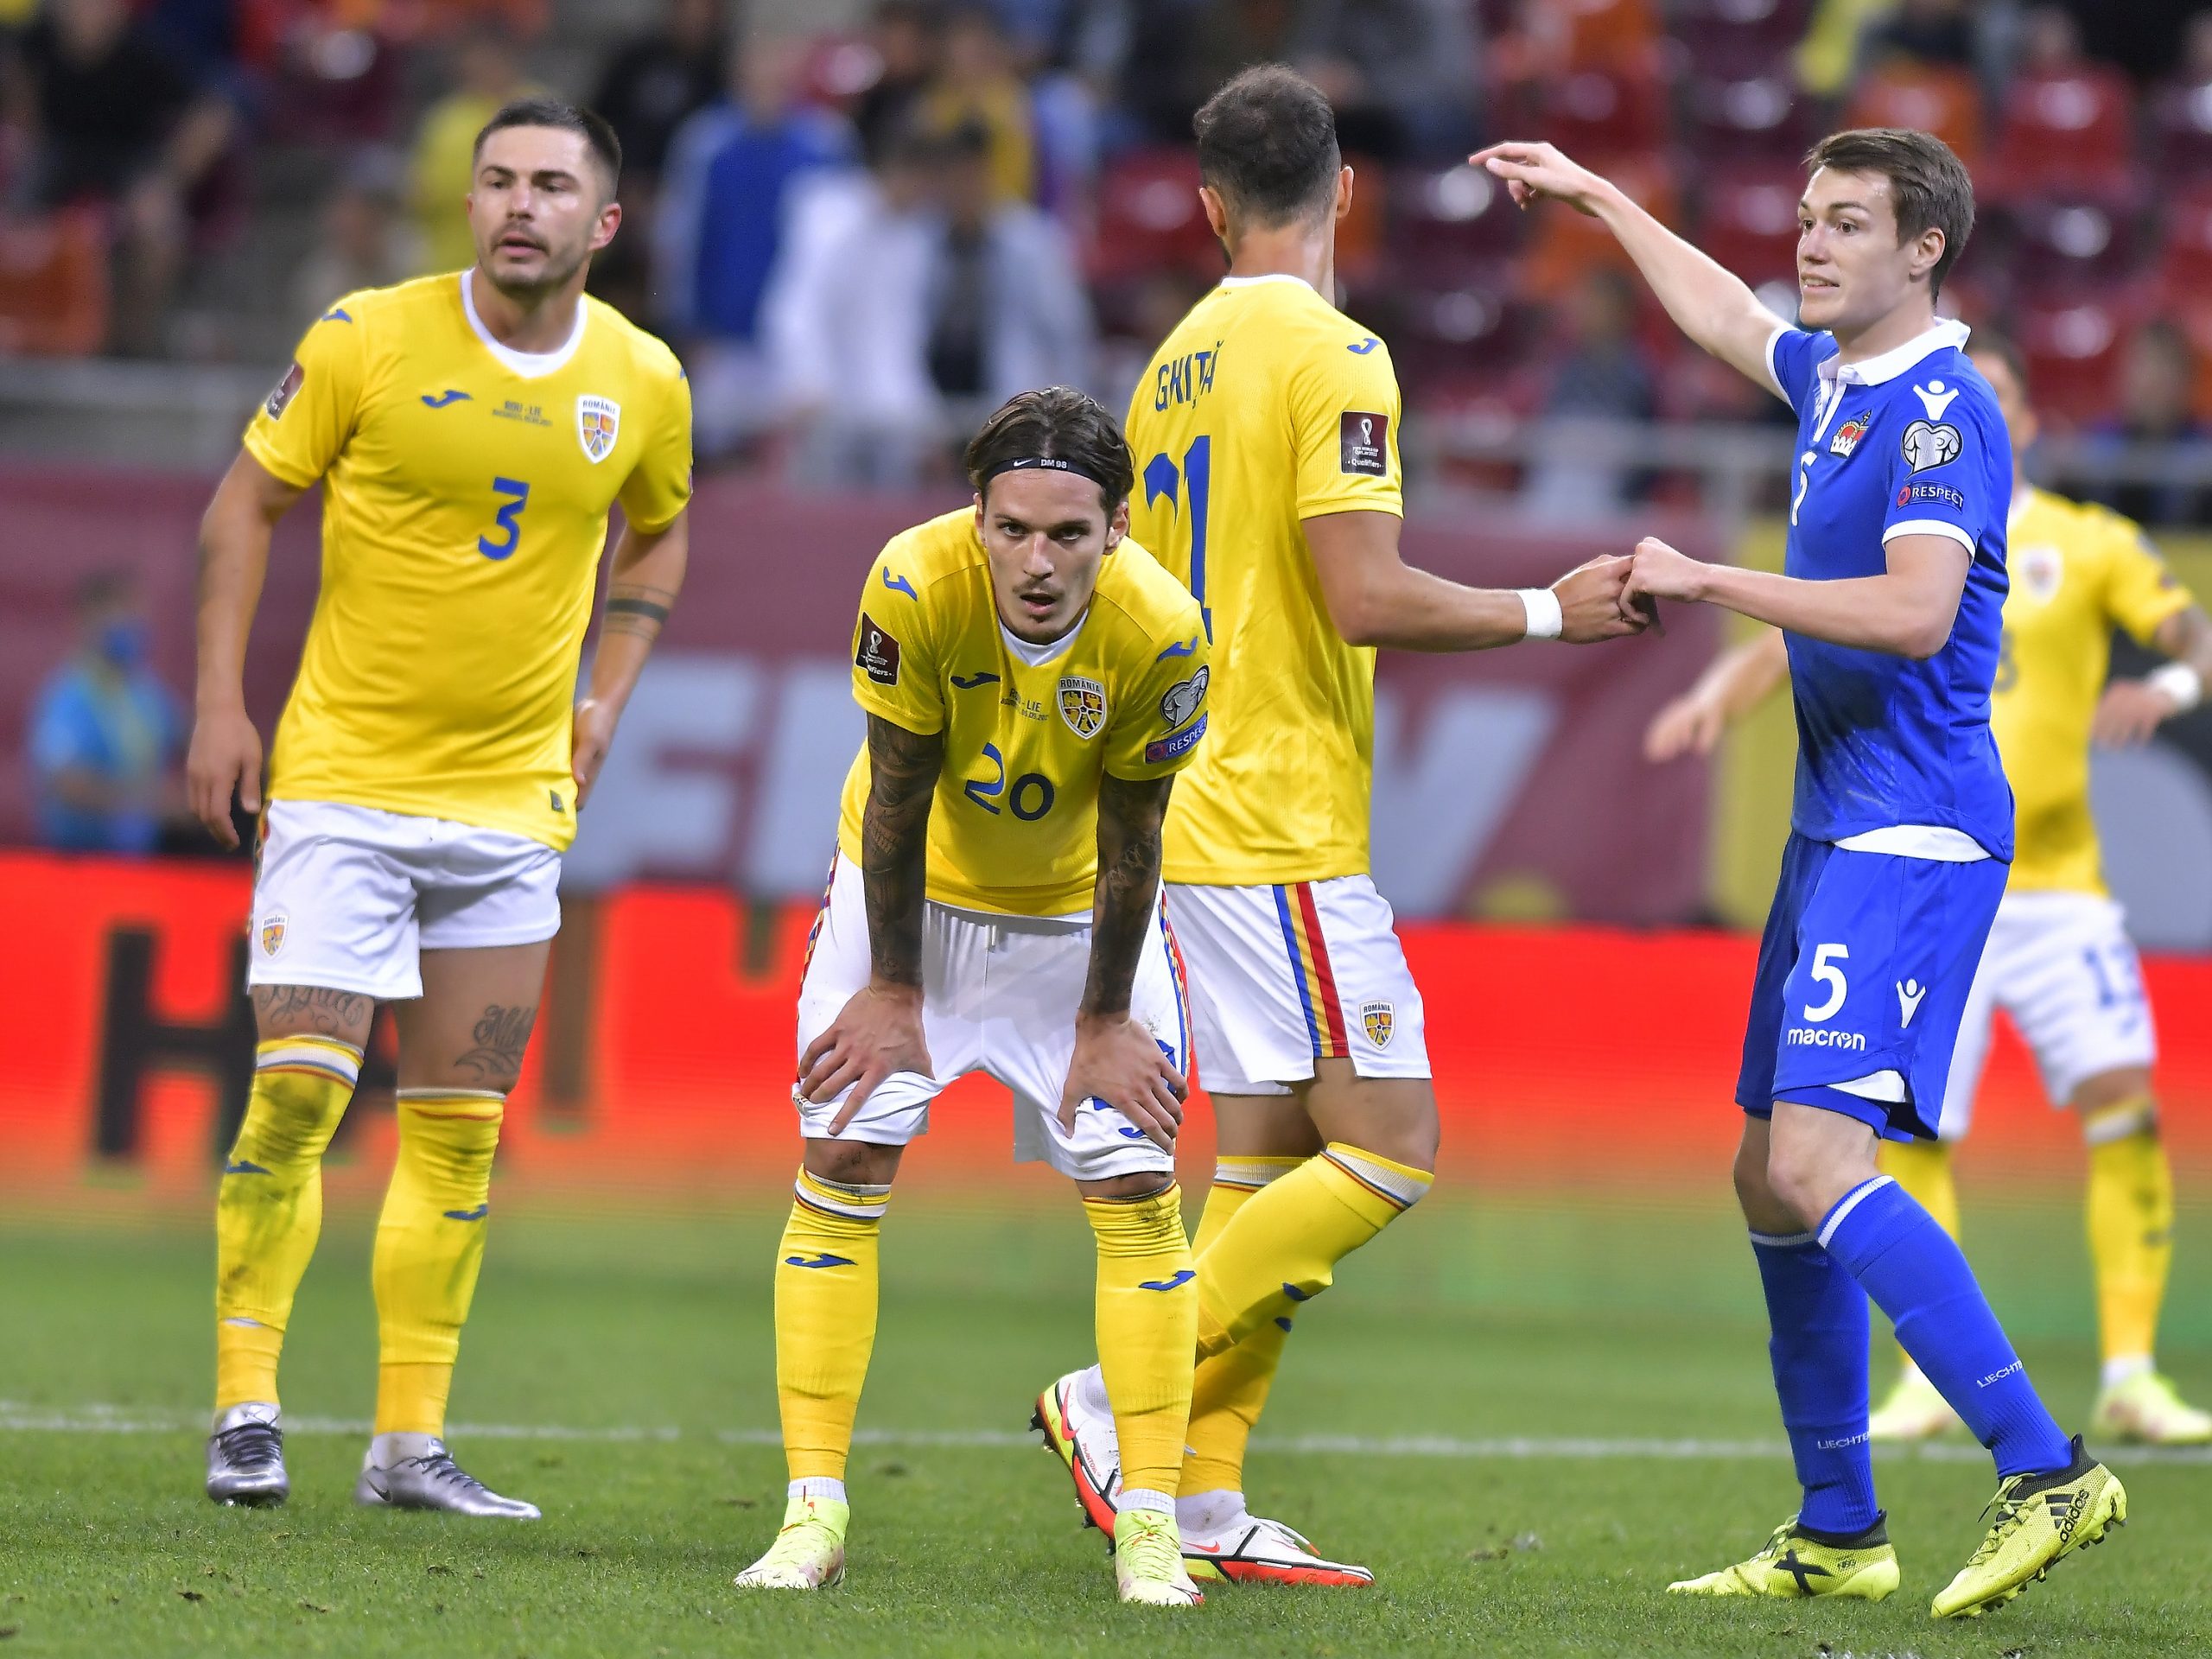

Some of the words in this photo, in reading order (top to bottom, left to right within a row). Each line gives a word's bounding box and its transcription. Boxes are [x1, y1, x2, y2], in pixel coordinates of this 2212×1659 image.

[1040, 459, 1055, 467] DM
[1056, 460, 1067, 468] 98
[1912, 486, 1964, 508] RESPECT
[478, 475, 531, 561] 3
[1027, 700, 1042, 713] LIE
[963, 741, 1055, 822] 20
[1803, 943, 1850, 1022] 5
[1787, 1028, 1866, 1052] macron
[2060, 1490, 2089, 1543] adidas
